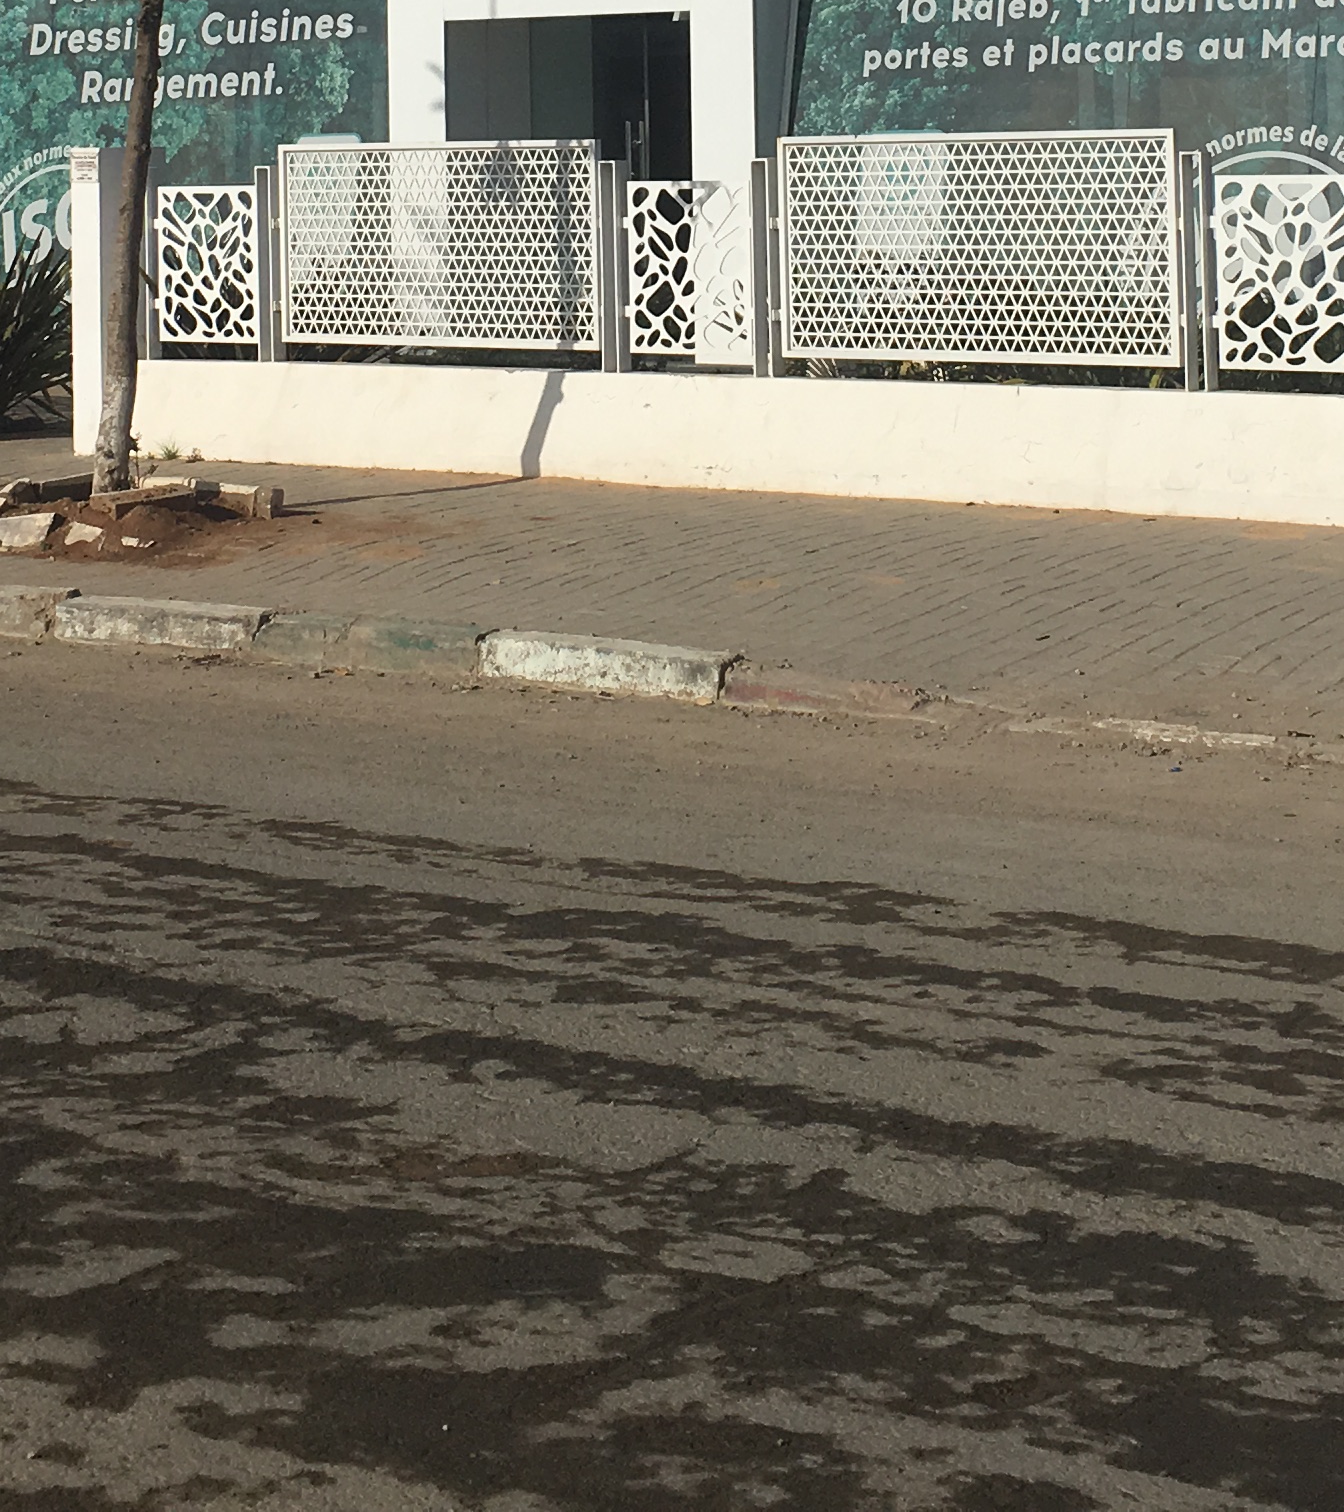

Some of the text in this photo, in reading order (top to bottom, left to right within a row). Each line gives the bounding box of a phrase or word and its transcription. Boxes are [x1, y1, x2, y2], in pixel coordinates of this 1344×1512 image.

[30, 8, 354, 57] Dressig, Cuisines
[862, 41, 968, 77] portes
[983, 38, 1014, 66] et
[1028, 32, 1183, 73] placards
[1199, 37, 1244, 60] au
[23, 144, 71, 170] norme
[1206, 125, 1294, 157] normes
[1300, 124, 1328, 152] de
